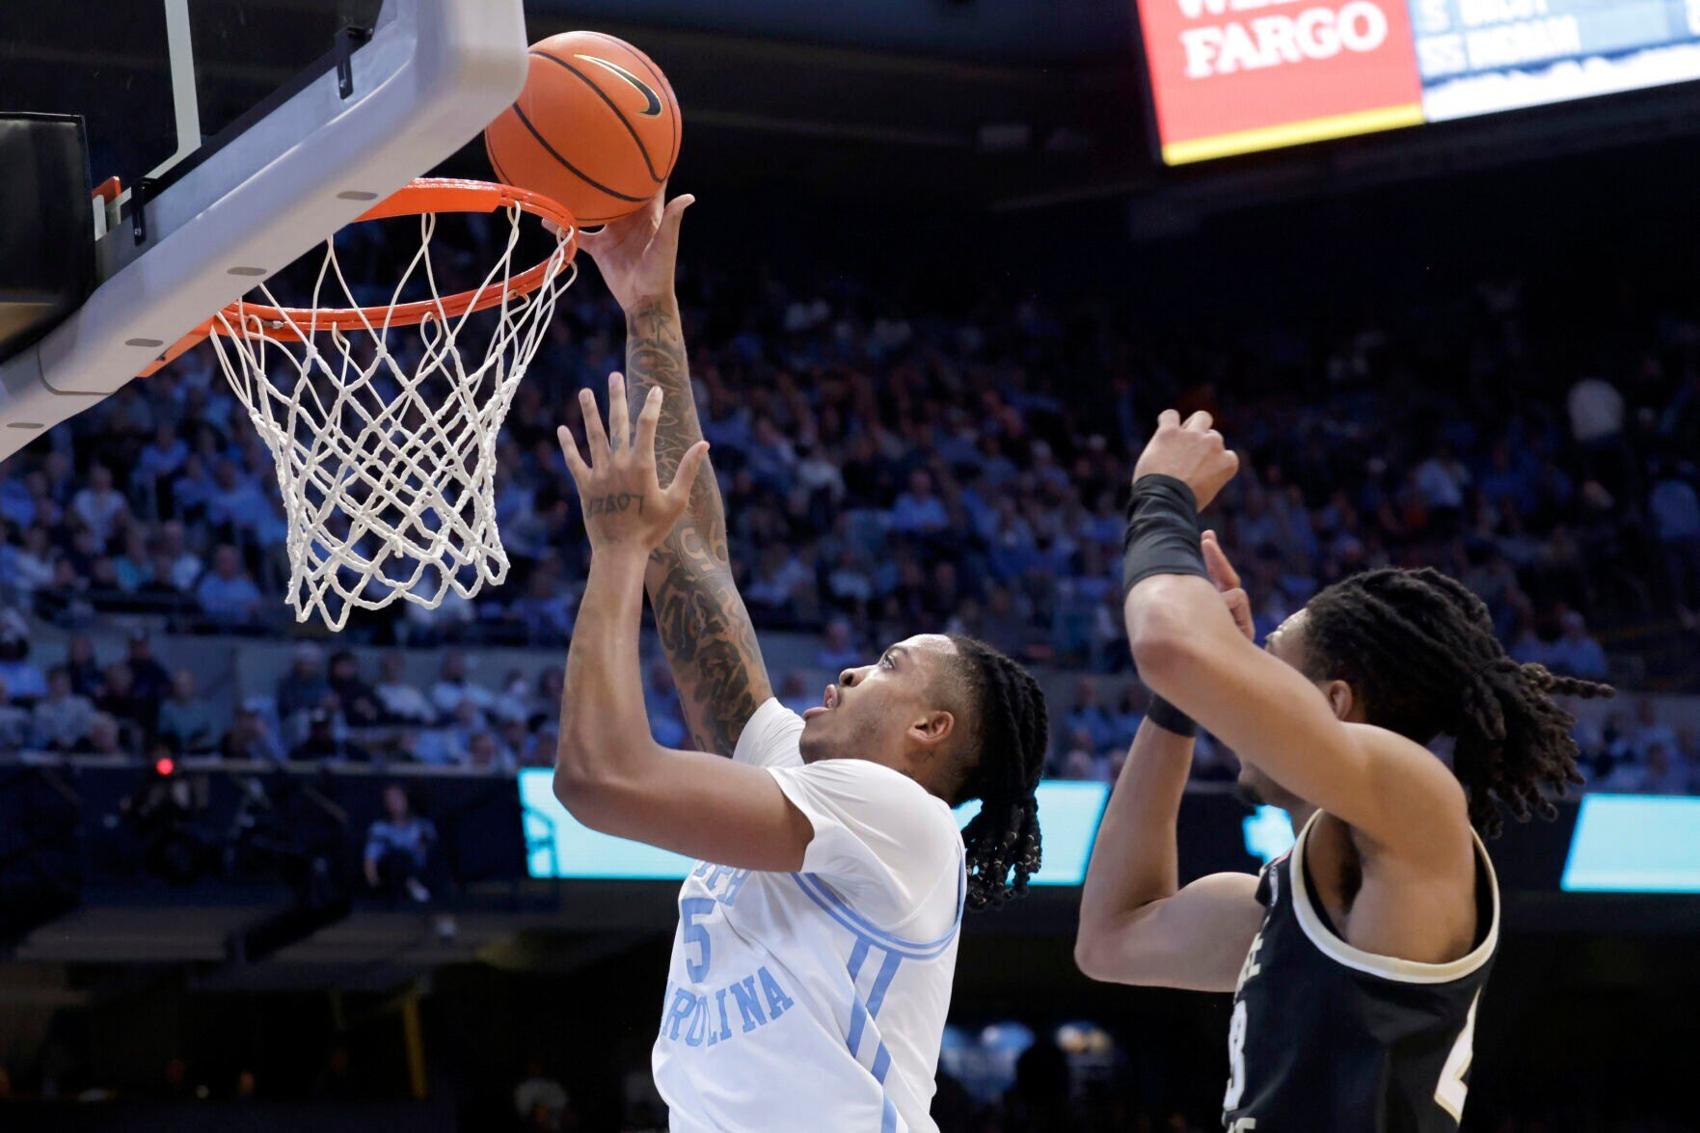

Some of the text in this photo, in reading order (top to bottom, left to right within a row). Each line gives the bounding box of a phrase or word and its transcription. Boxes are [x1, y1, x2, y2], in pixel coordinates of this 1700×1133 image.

[1179, 2, 1388, 79] FARGO
[681, 897, 717, 984] 5
[661, 966, 795, 1047] ROLINA
